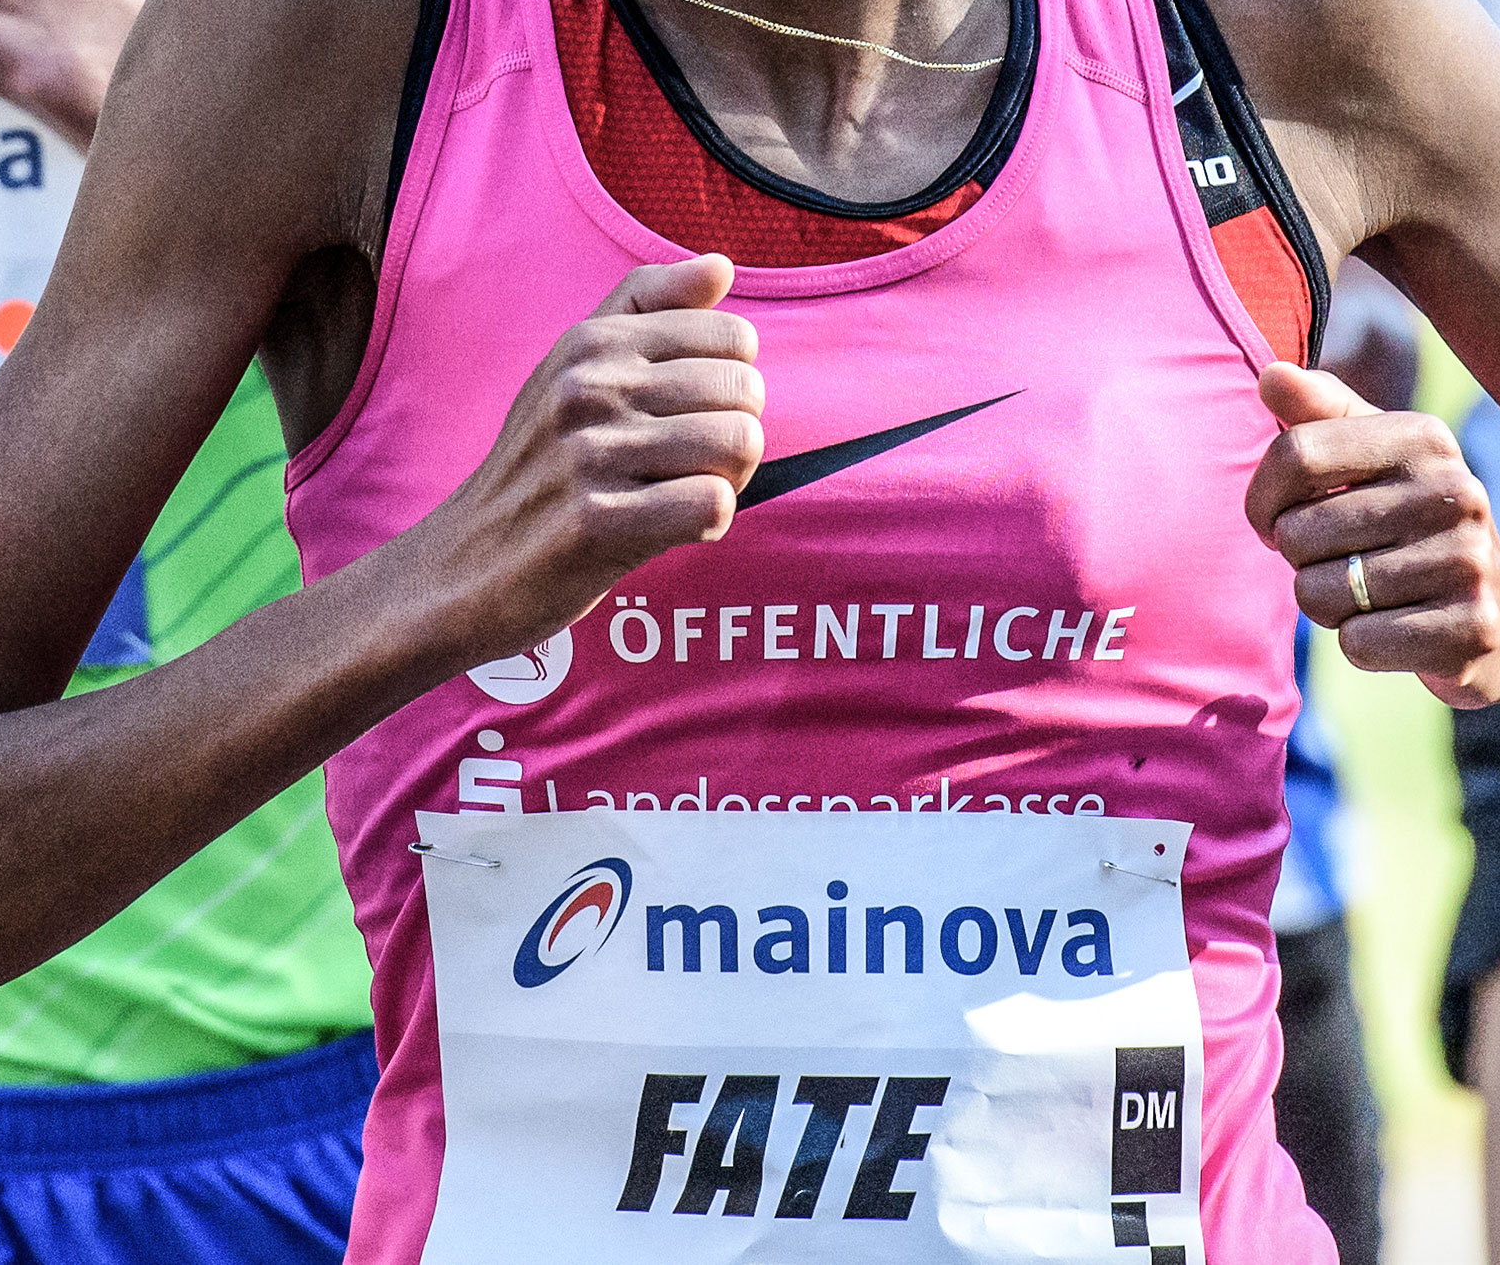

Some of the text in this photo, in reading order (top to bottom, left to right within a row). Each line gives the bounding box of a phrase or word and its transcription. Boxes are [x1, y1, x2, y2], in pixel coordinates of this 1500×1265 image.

[610, 596, 1136, 662] ÖFFENTLICHE
[645, 880, 1114, 976] mainova
[616, 1073, 951, 1221] FATE
[1119, 1090, 1177, 1131] DM
